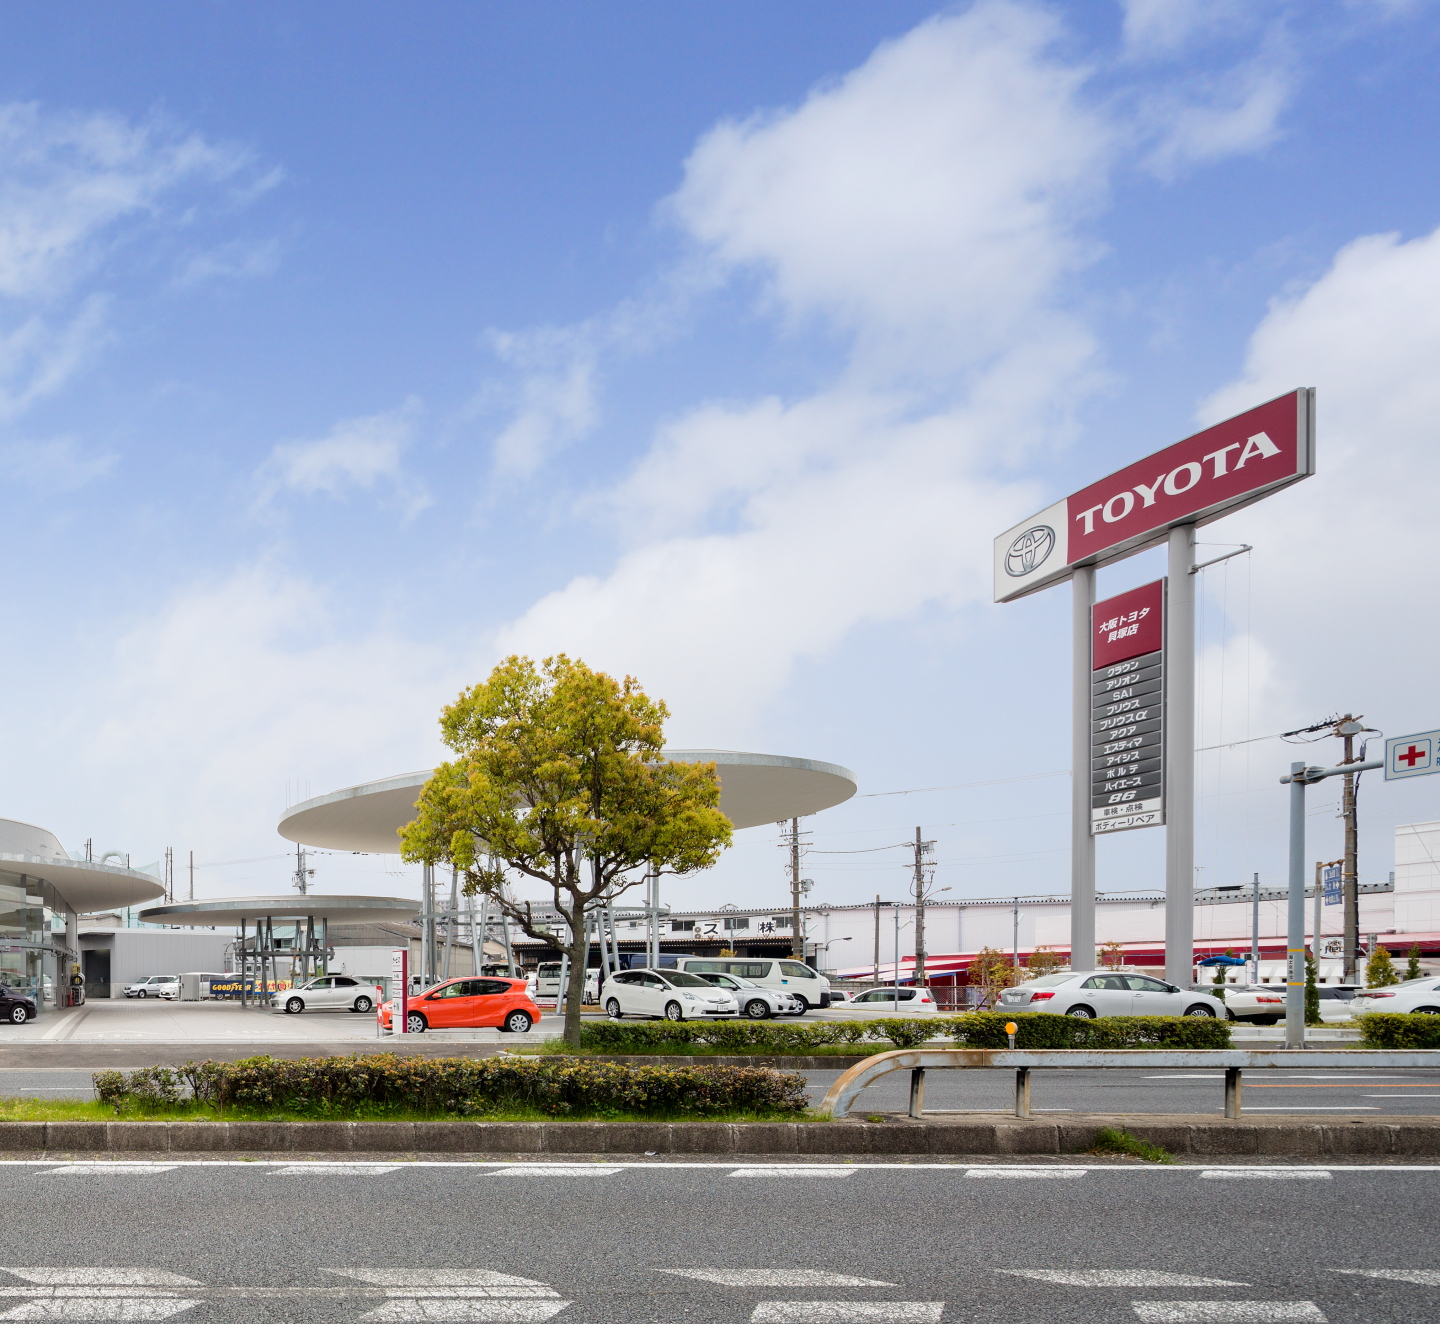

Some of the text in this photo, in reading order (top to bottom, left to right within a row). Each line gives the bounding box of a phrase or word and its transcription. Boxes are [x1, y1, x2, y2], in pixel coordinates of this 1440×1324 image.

[1075, 431, 1283, 536] TOYOTA
[1098, 607, 1151, 634] 大阪トヨタ
[1107, 623, 1140, 643] 貝塚店
[1107, 661, 1139, 678] クラウン
[1106, 674, 1140, 691] アリオン
[1113, 687, 1133, 701] SAI
[1106, 699, 1140, 716] プリウス
[1110, 725, 1137, 741] アクア
[1103, 737, 1143, 755] エスティマ
[1106, 751, 1140, 767] アイシス
[1104, 776, 1142, 792] ハイエース
[1108, 790, 1137, 804] 86
[1103, 802, 1144, 816] 車検・点検
[1095, 814, 1156, 831] ボディーリペア
[212, 983, 251, 992] GOODYER
